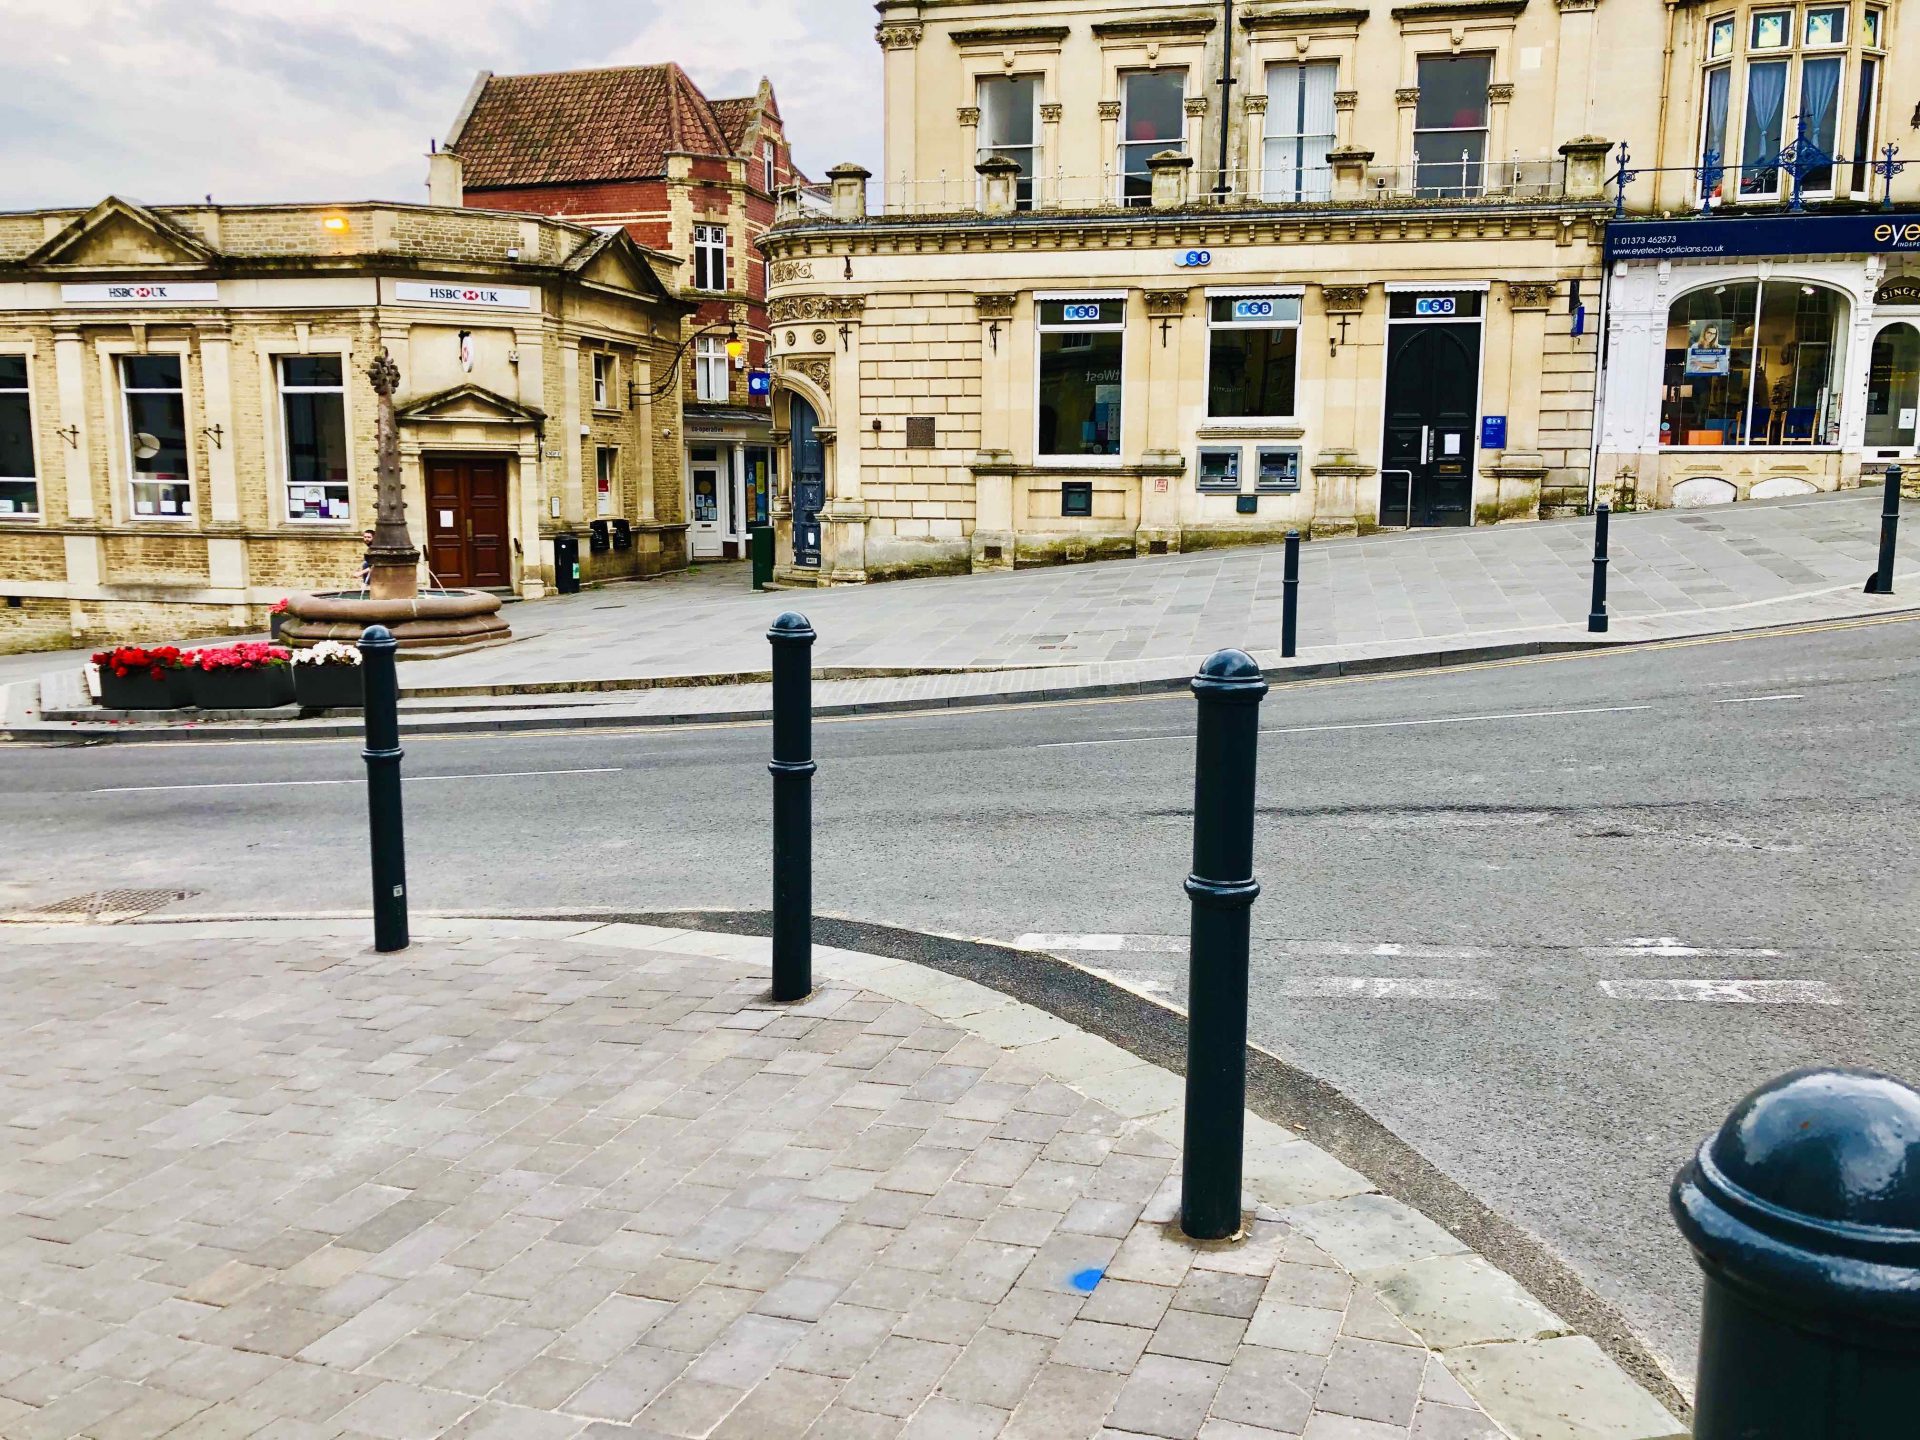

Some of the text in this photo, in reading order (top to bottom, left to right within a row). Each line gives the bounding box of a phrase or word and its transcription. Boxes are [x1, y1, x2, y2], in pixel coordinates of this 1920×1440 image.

[1621, 237, 1645, 245] 01373
[1647, 235, 1677, 244] 462573
[1874, 224, 1920, 246] eye
[1612, 245, 1724, 255] www.eyetech-opticians.co.uk
[108, 287, 168, 297] HSBC UK
[429, 288, 498, 301] HSBC UK
[1239, 304, 1270, 314] TSB
[1420, 301, 1452, 312] TSB
[1067, 307, 1097, 318] TSB
